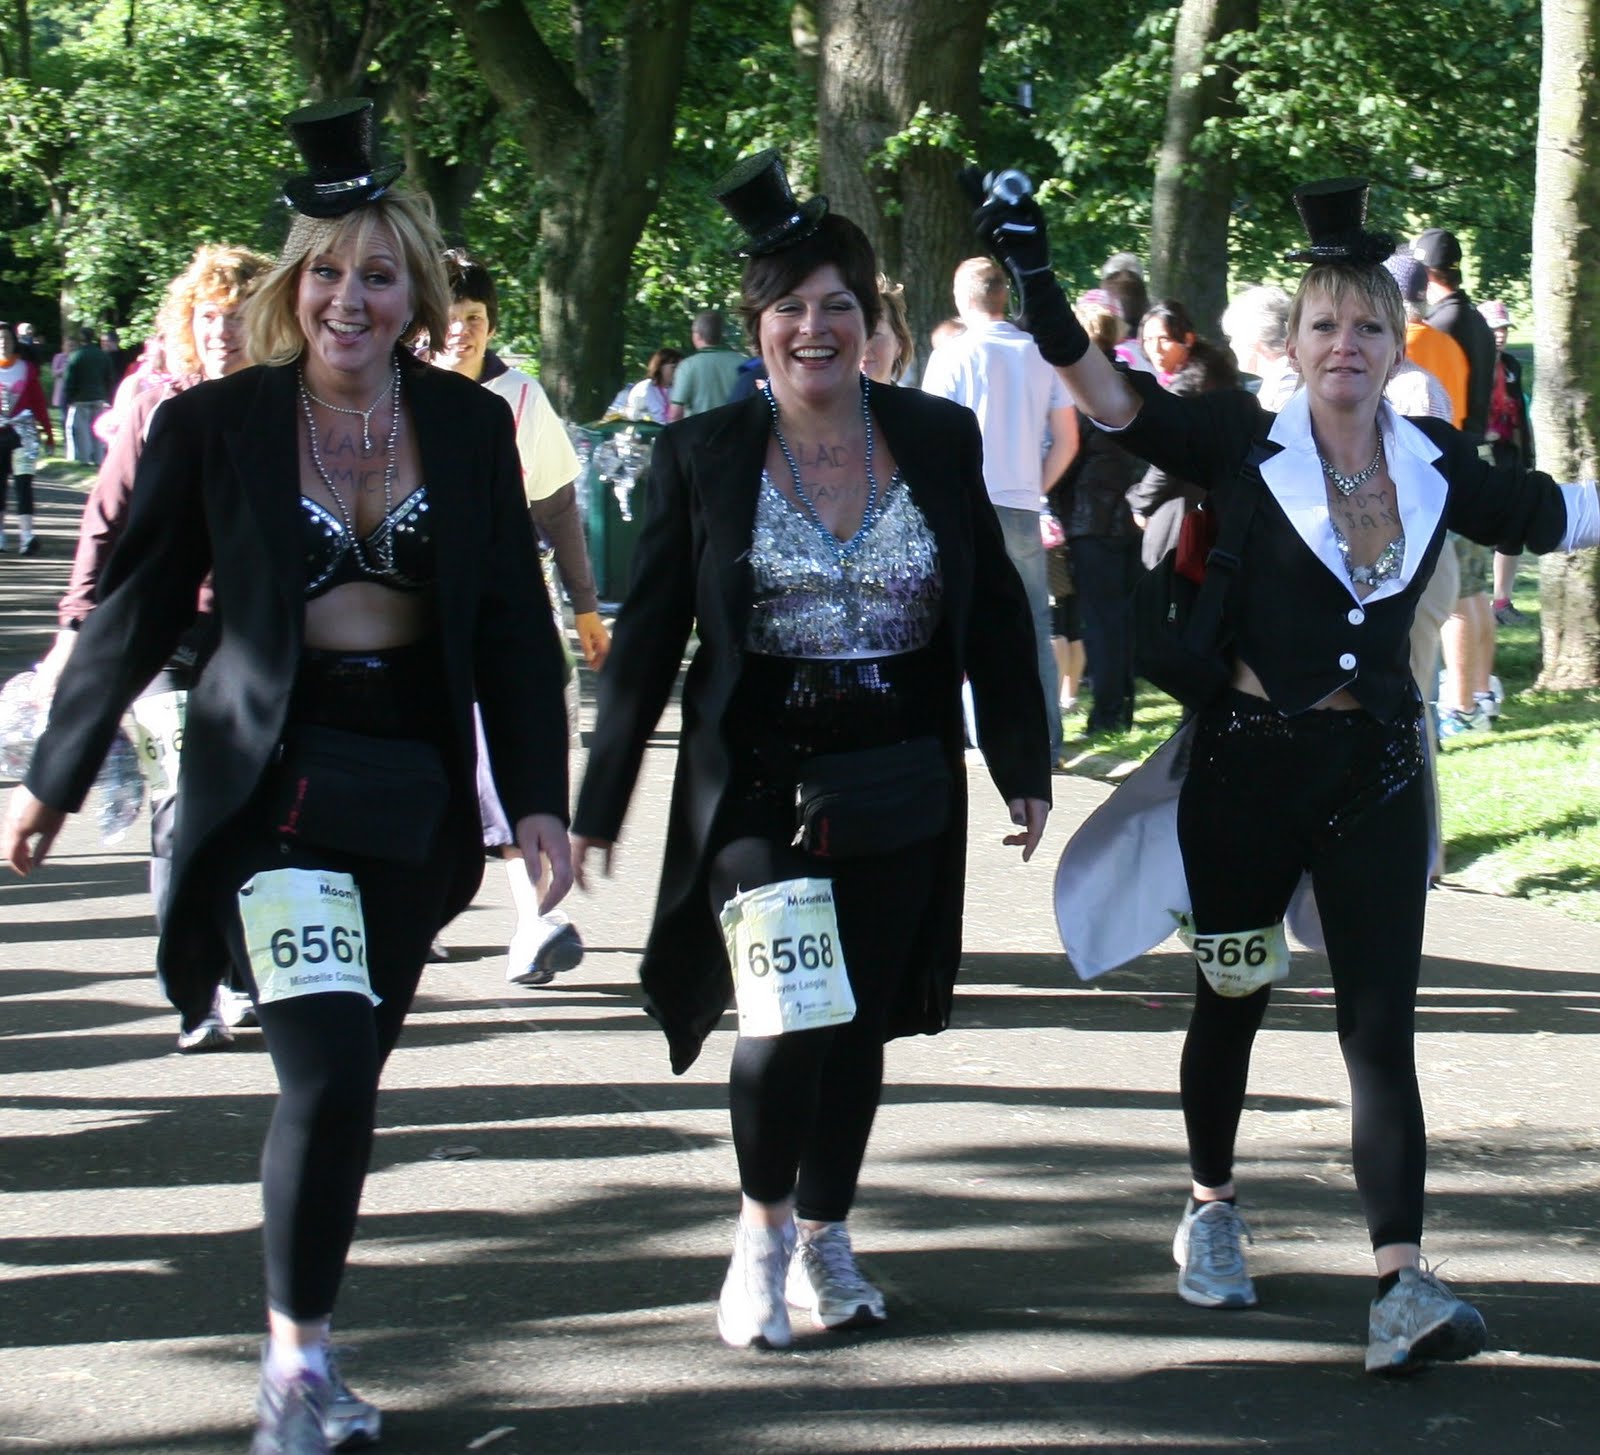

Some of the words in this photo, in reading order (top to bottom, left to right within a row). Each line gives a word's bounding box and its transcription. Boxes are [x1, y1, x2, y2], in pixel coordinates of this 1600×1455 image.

[323, 428, 391, 459] LAD
[270, 925, 364, 969] 6567
[748, 932, 834, 978] 6568
